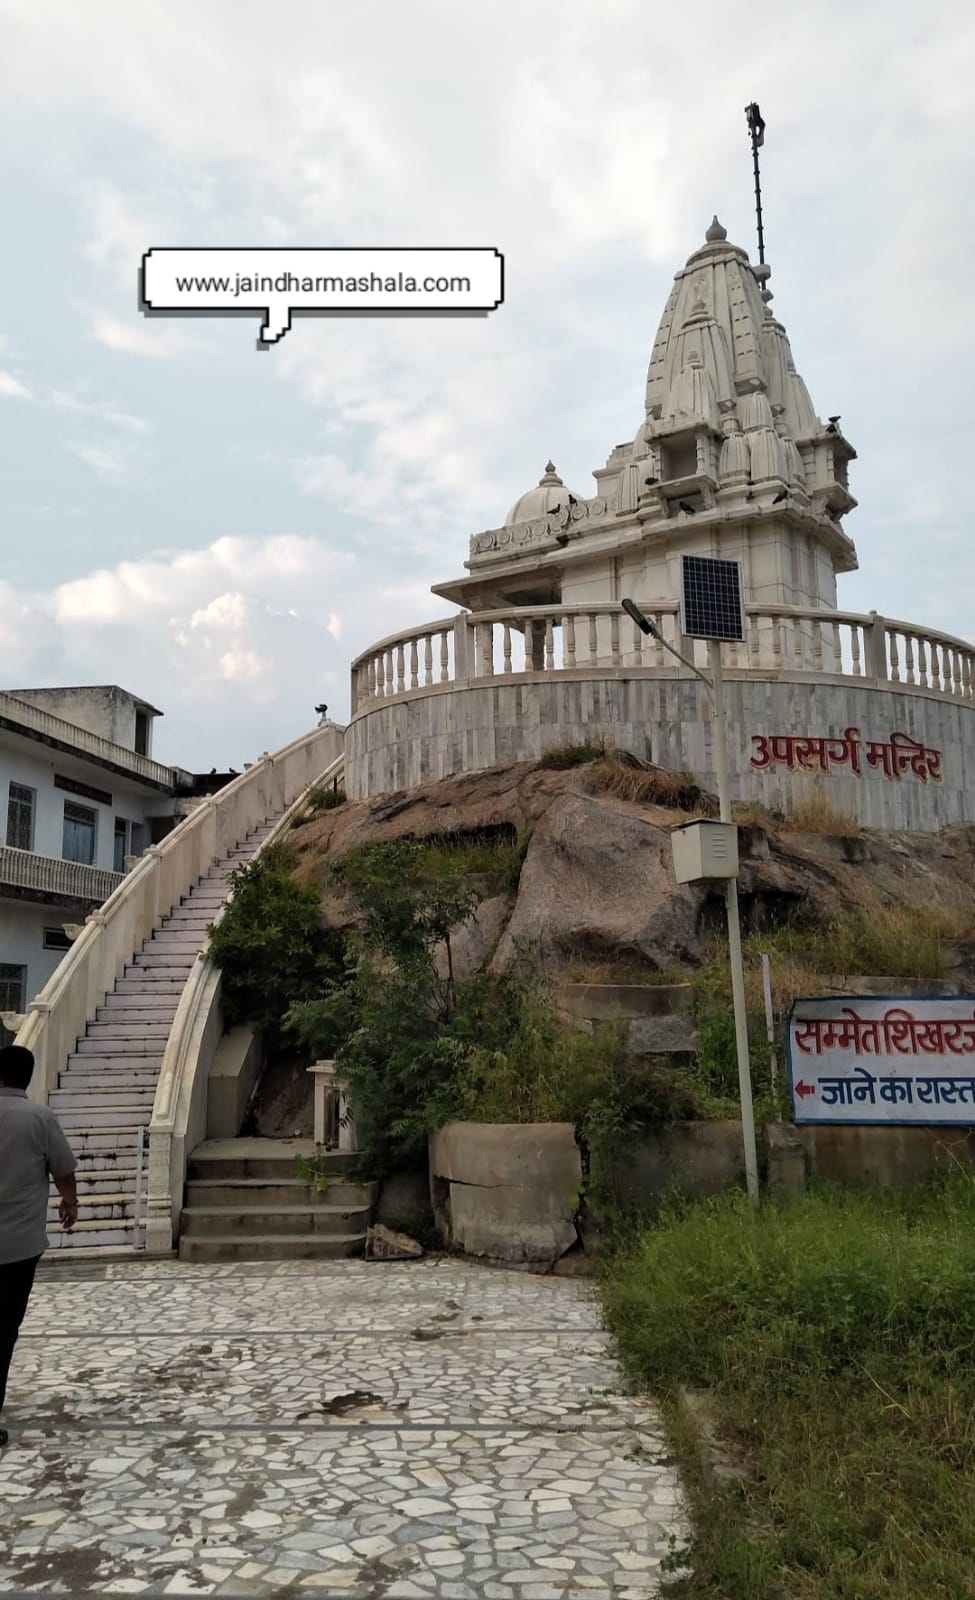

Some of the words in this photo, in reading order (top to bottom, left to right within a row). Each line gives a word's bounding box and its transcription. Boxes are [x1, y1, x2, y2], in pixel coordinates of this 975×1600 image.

[750, 727, 862, 776] उपसर्ग
[866, 732, 943, 783] मन्दिर
[881, 1008, 975, 1055] शिखरज
[818, 1067, 877, 1104] जाने
[879, 1077, 913, 1104] का
[915, 1077, 975, 1104] रास्त
